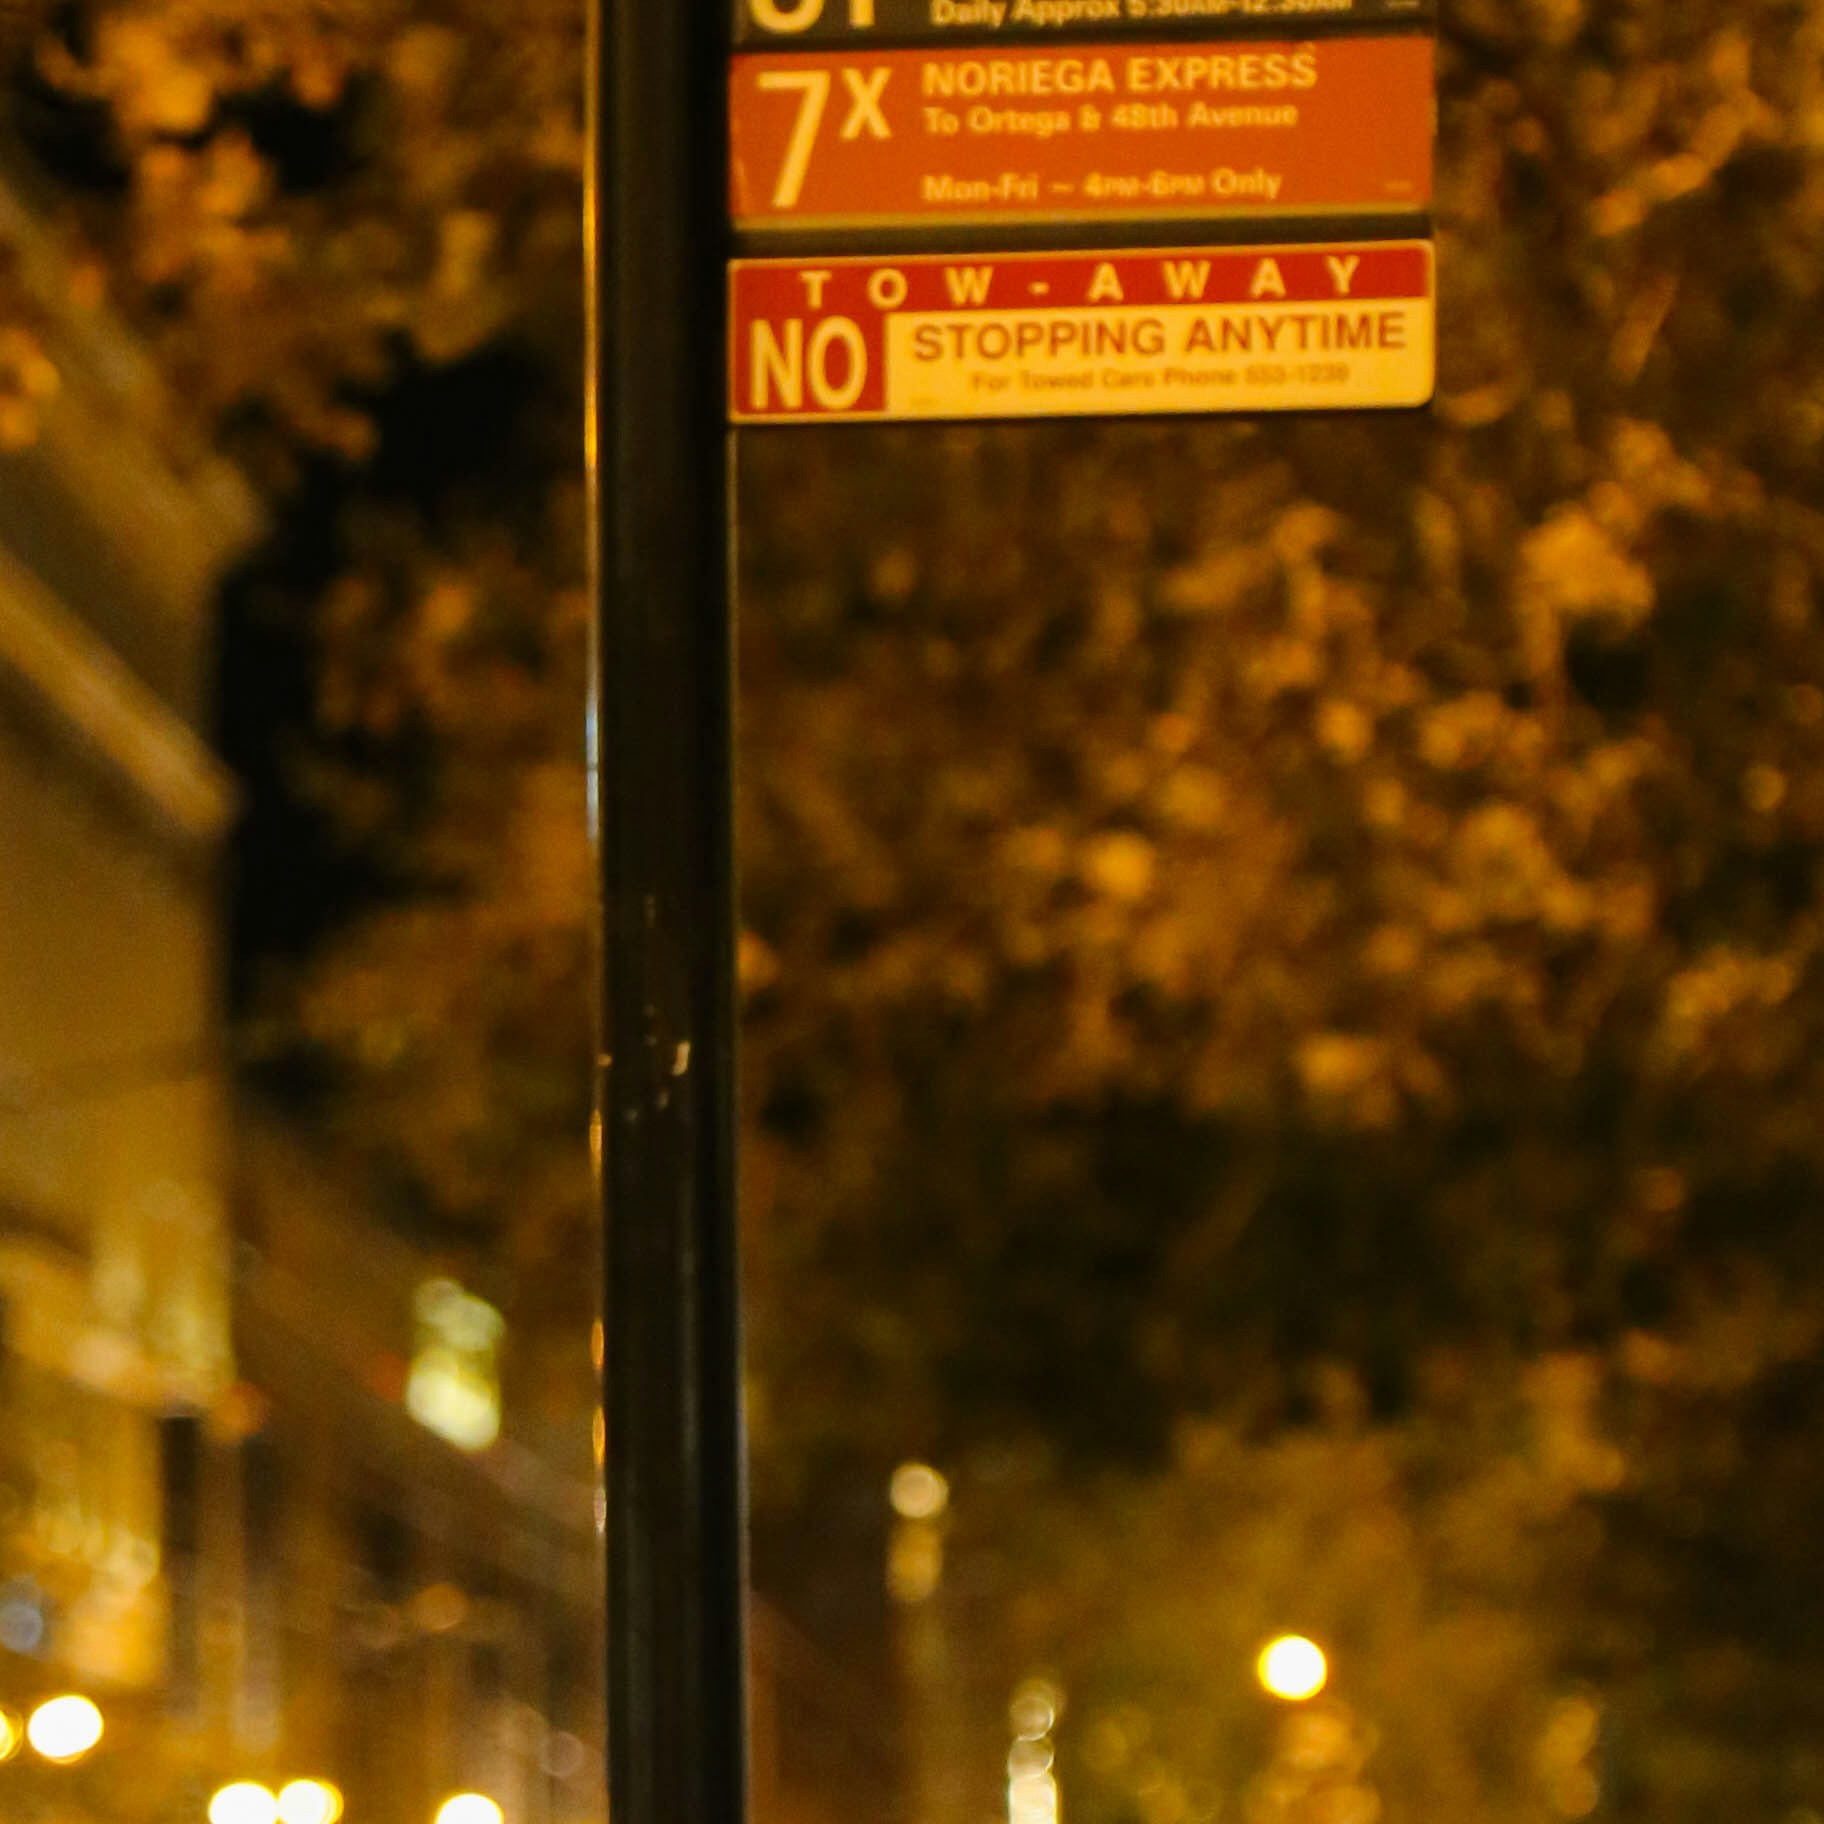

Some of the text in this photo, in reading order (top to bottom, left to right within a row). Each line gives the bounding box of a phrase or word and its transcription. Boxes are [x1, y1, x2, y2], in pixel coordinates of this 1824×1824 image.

[923, 56, 1318, 96] NORIEGA EXPRESS
[923, 107, 960, 135] To
[969, 106, 1071, 137] Ortega
[1188, 101, 1298, 127] Avenue
[923, 173, 1039, 202] Mon-Fri
[1212, 167, 1281, 199] Only
[912, 311, 1406, 362] STOPPING ANYTIME
[750, 315, 868, 410] NO
[1164, 367, 1235, 386] Phone
